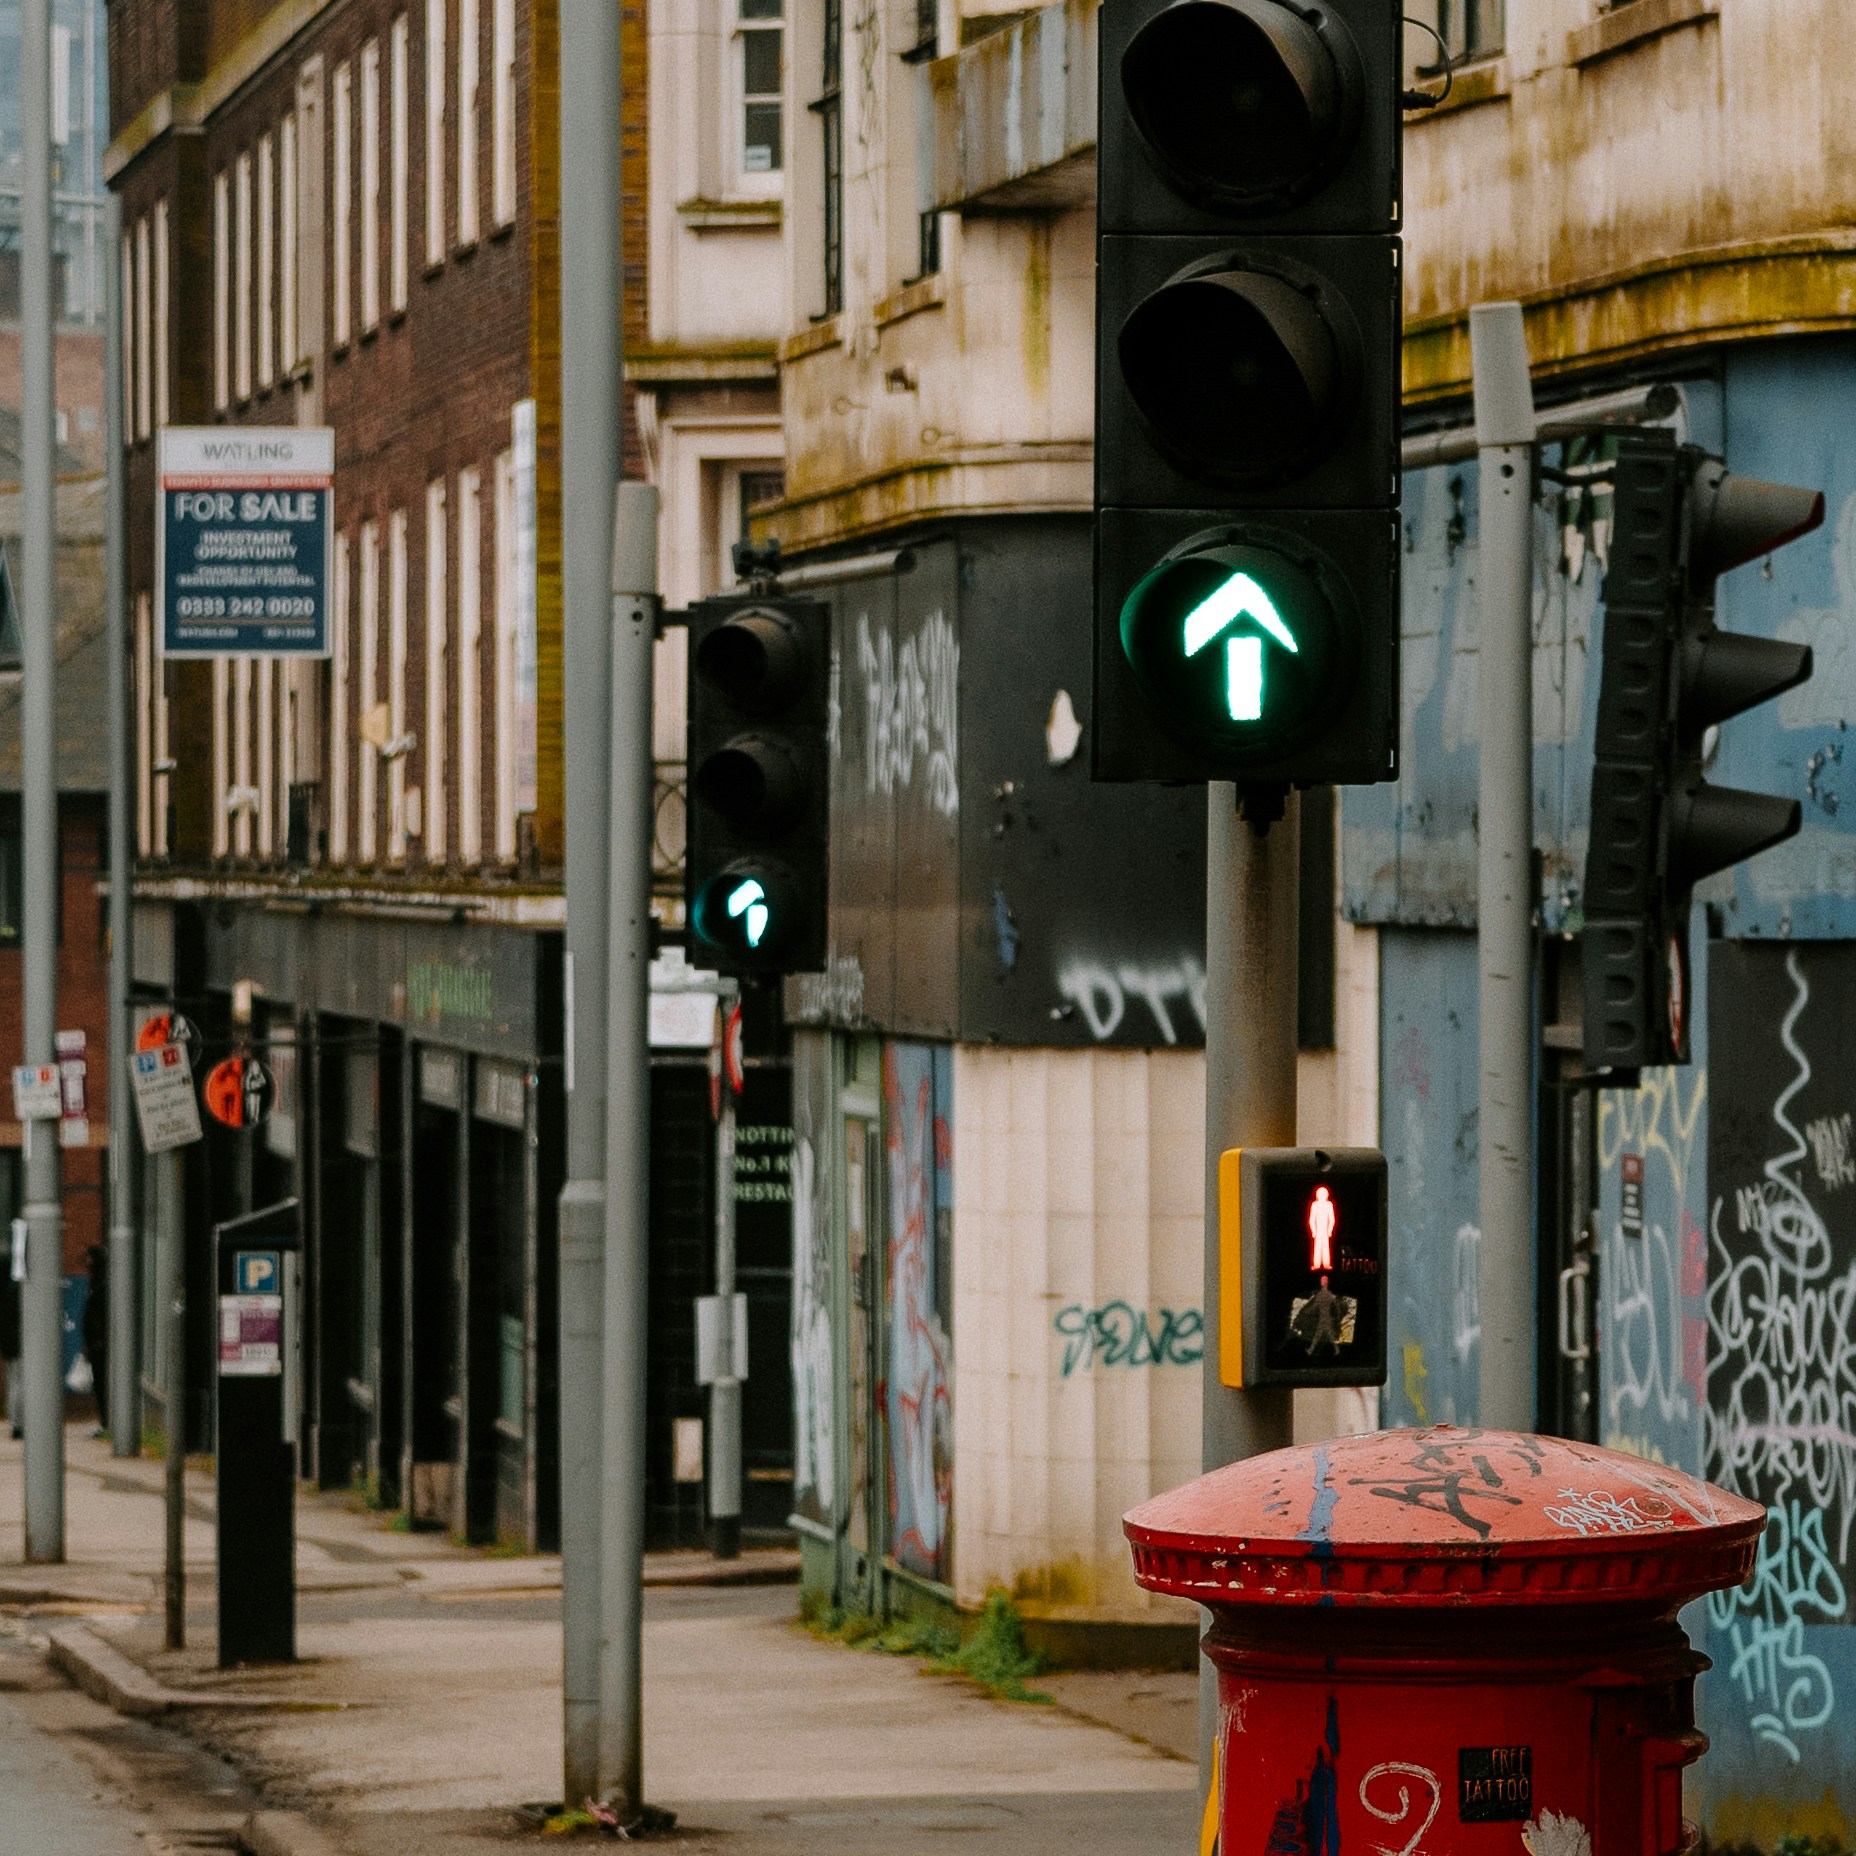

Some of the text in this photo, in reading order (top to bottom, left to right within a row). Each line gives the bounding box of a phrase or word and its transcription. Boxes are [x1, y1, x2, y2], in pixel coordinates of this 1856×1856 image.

[204, 443, 294, 460] WATLING
[174, 493, 317, 522] FOR SALE
[202, 531, 292, 545] INVESTMENT
[195, 545, 298, 560] OPPORTUNITY
[178, 597, 315, 616] 0333 242 0020
[246, 1258, 273, 1289] P
[1490, 1747, 1528, 1775] FREE
[1463, 1777, 1531, 1803] TATTOO
